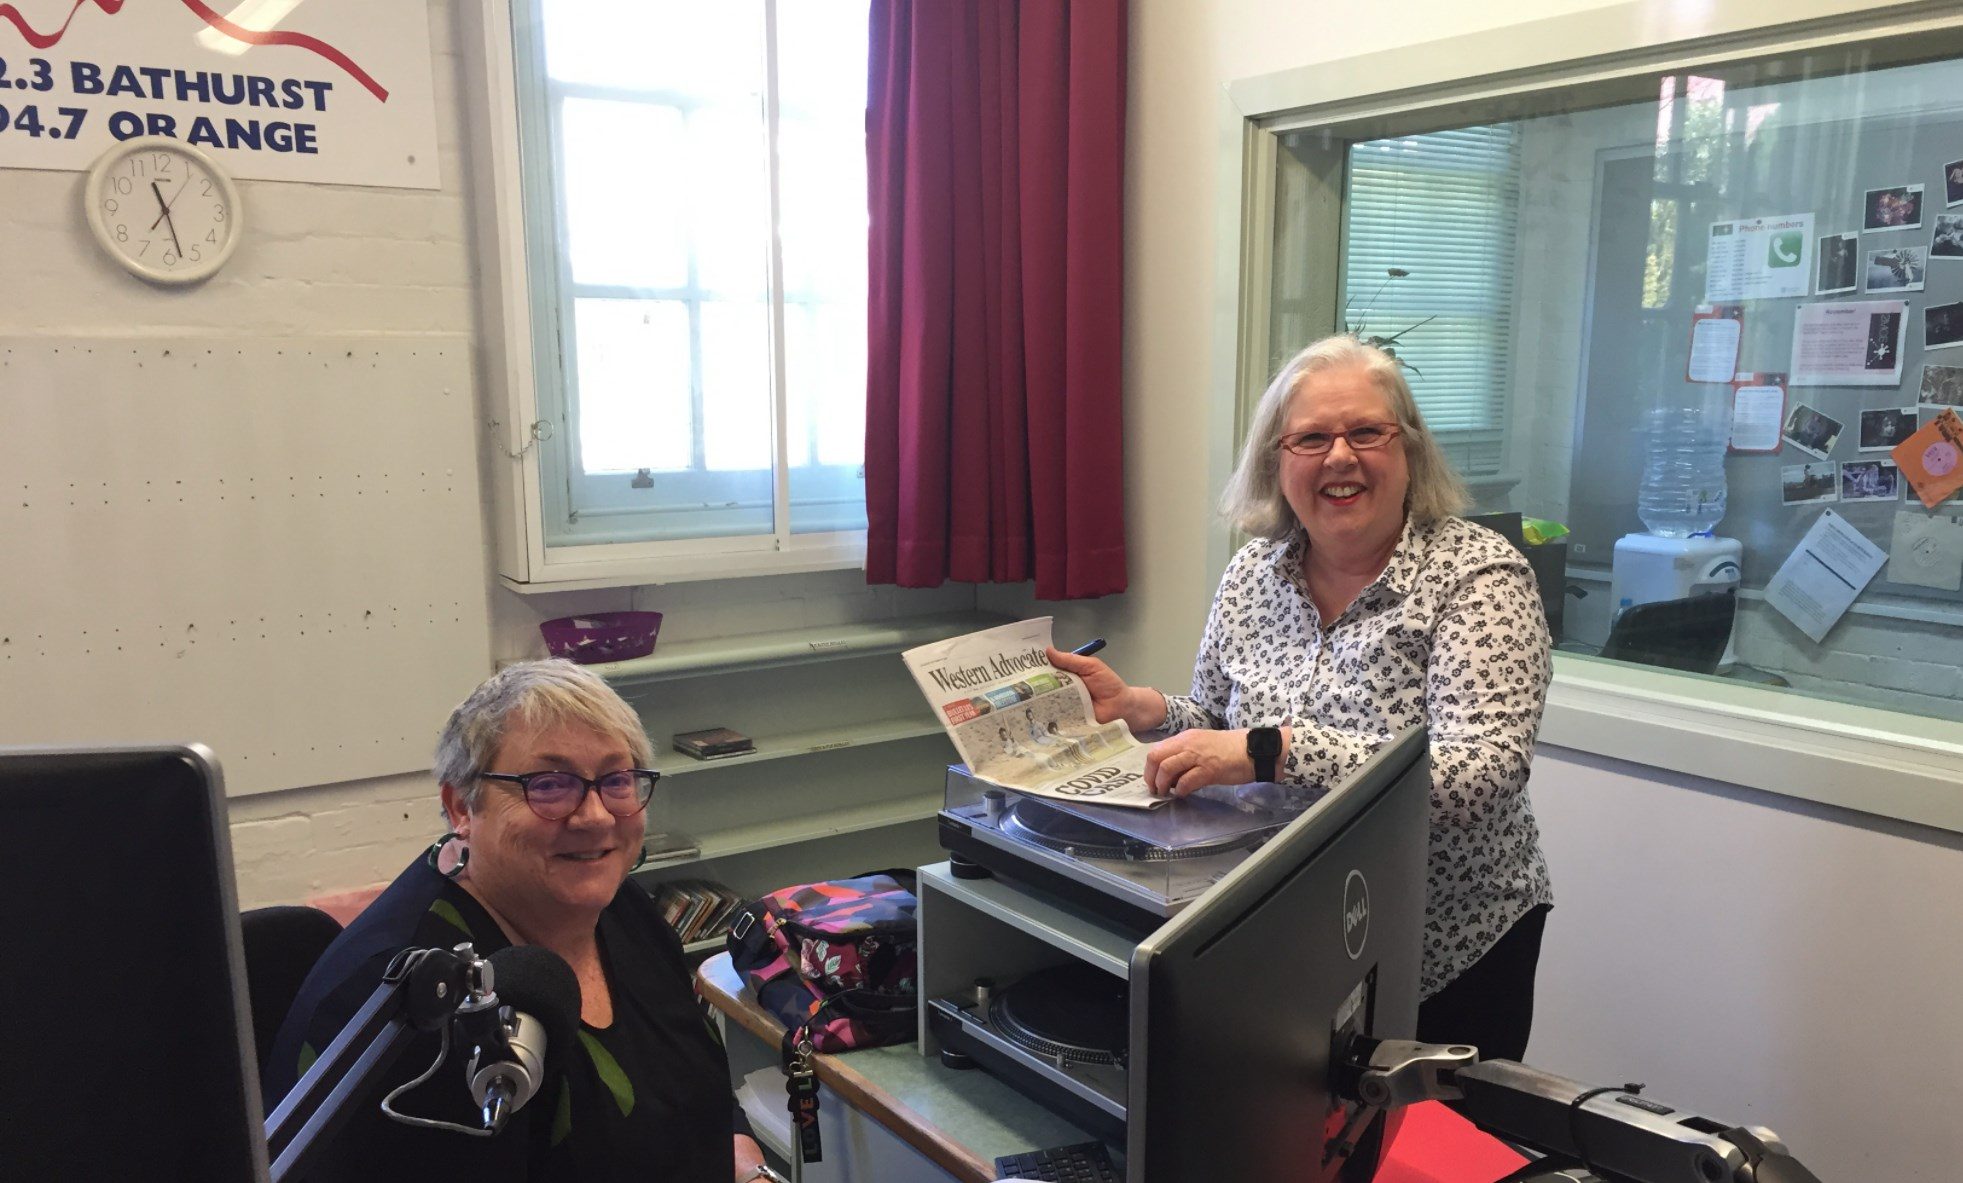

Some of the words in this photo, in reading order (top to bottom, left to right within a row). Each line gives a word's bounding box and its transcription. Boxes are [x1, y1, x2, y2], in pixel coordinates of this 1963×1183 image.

[70, 61, 333, 112] BATHURST
[108, 111, 319, 155] ORANGE
[130, 159, 145, 177] 11
[152, 153, 172, 173] 12
[112, 176, 132, 195] 10
[200, 178, 213, 198] 2
[104, 198, 119, 217] 9
[213, 203, 225, 223] 3
[116, 223, 129, 243] 8
[205, 228, 217, 245] 4
[1739, 223, 1766, 233] Phone
[1767, 220, 1804, 231] numbers
[138, 239, 151, 258] 7
[162, 248, 177, 266] 6
[188, 243, 201, 262] 5
[928, 664, 991, 693] Western
[988, 647, 1049, 680] Advocate
[1055, 766, 1121, 795] COVID
[1346, 896, 1367, 934] DELL
